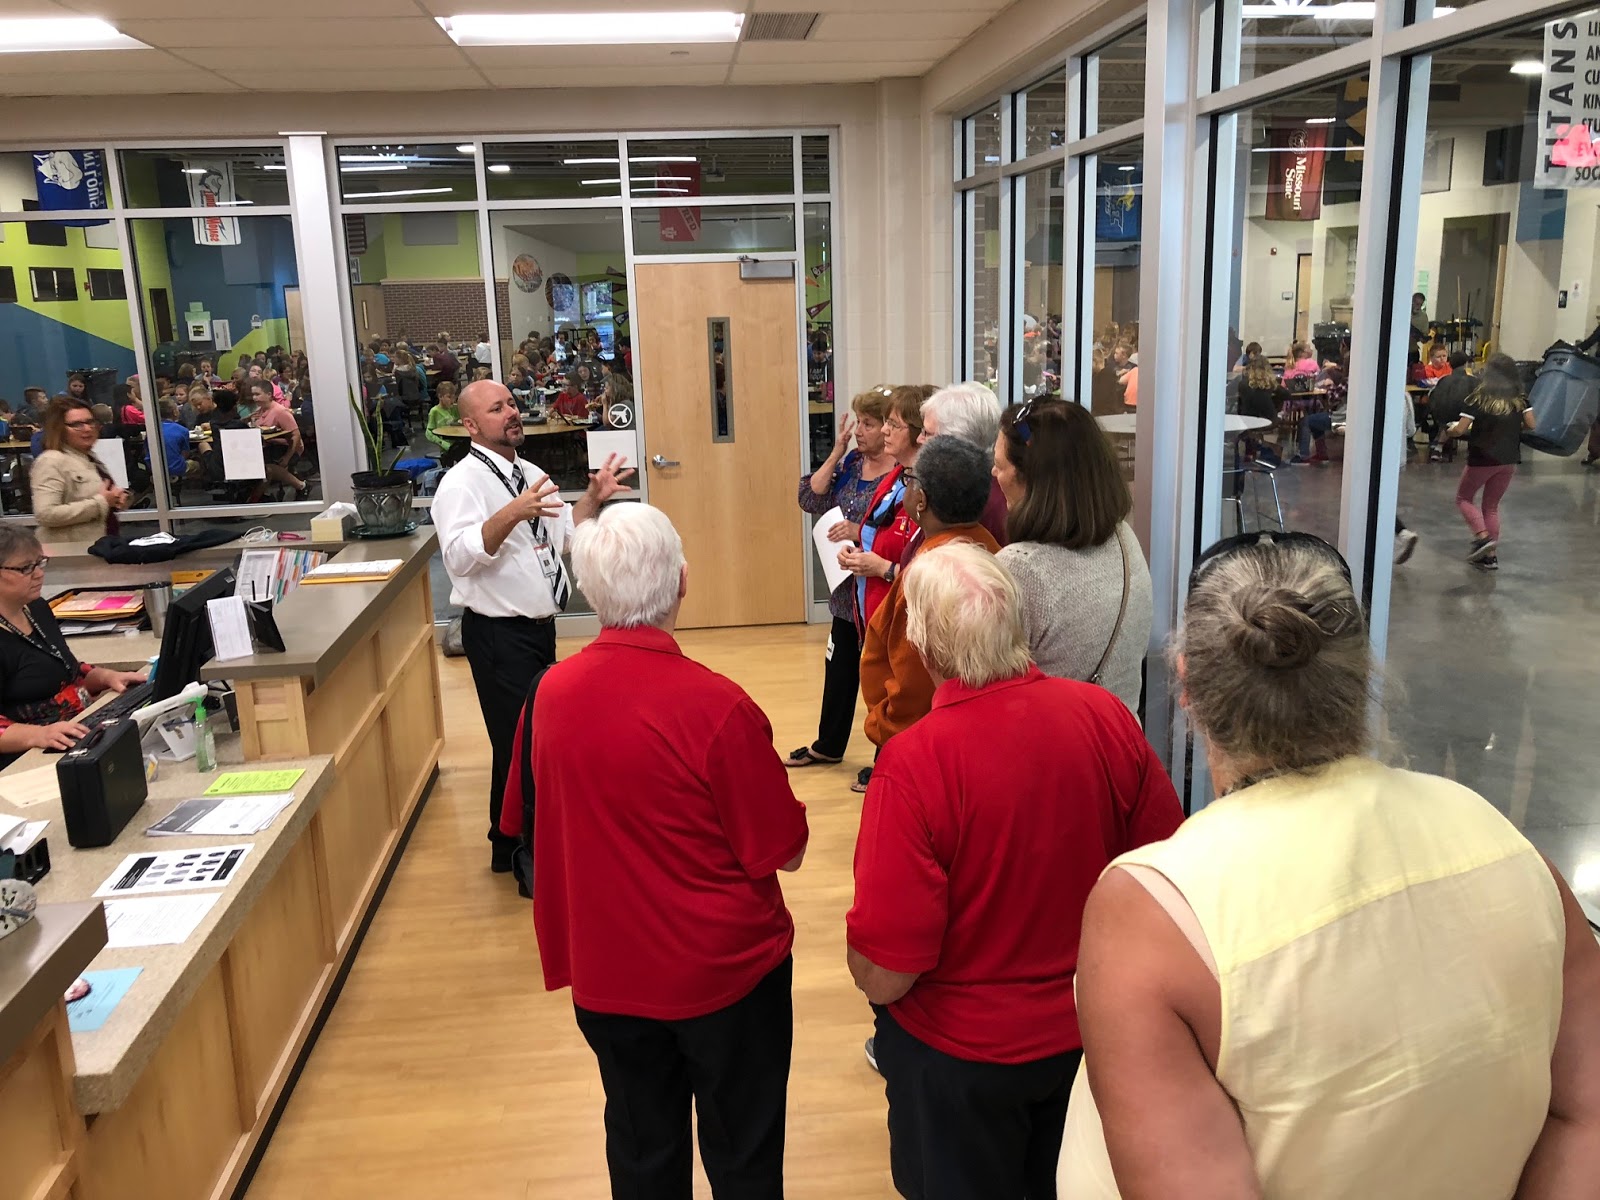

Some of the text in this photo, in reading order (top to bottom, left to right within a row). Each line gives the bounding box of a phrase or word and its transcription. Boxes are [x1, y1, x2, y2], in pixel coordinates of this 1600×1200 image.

[1544, 22, 1577, 173] TITANS
[1284, 168, 1296, 199] State
[1293, 156, 1307, 211] Missouri
